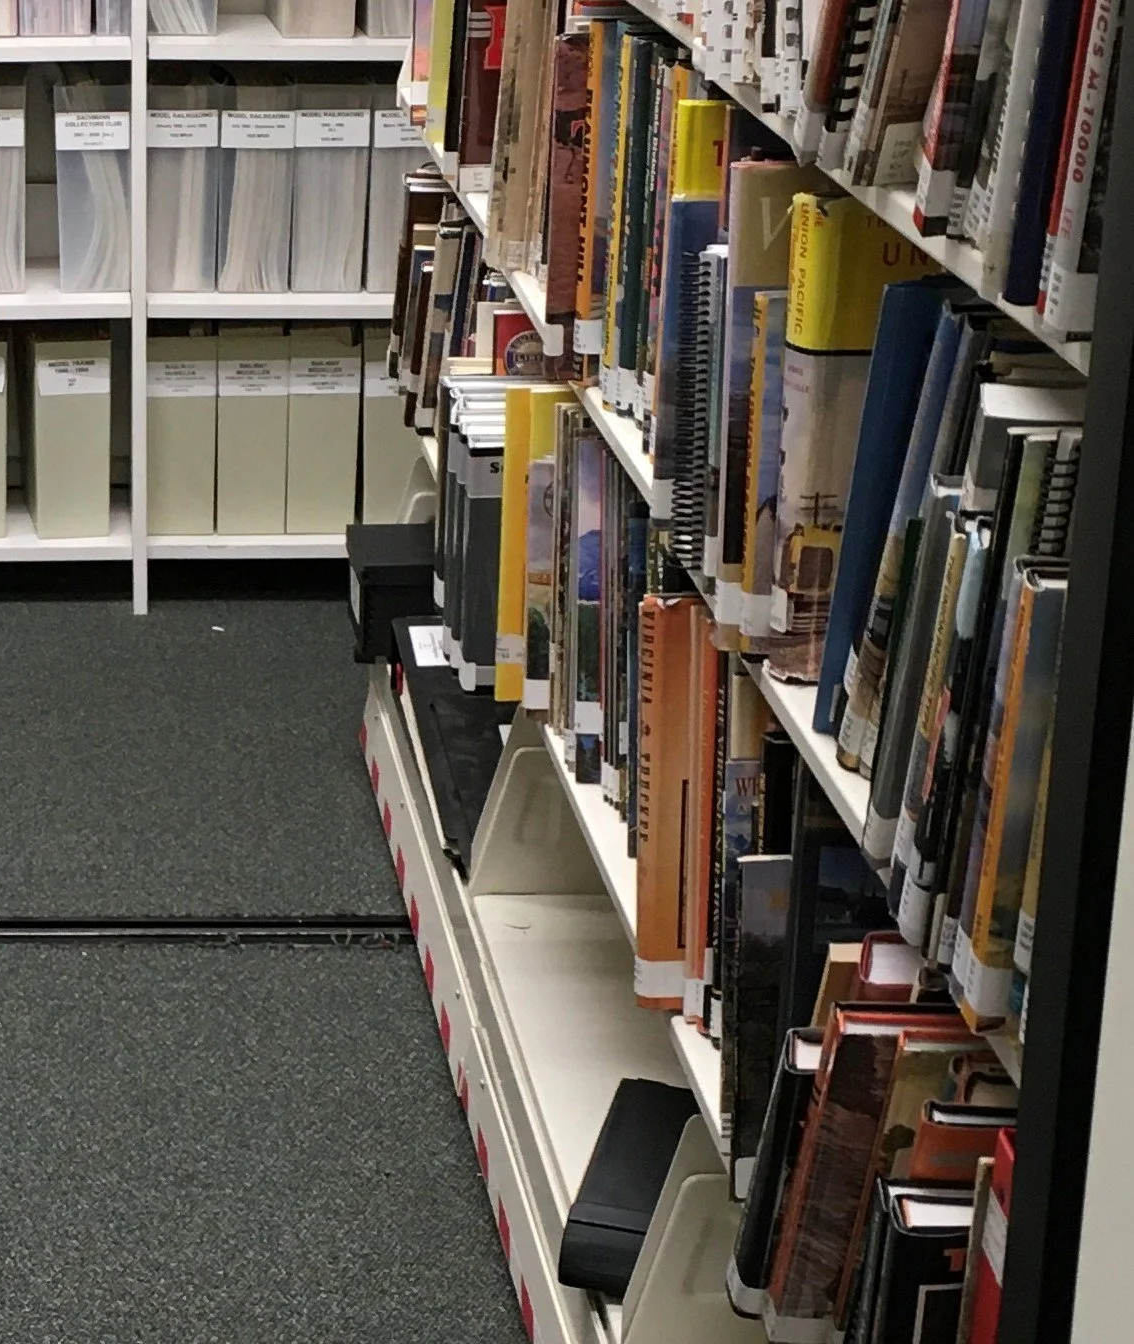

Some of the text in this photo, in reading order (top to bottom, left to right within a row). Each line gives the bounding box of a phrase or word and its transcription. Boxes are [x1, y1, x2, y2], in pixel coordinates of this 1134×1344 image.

[1072, 68, 1100, 184] M-10000
[794, 202, 809, 336] UNION PACIFIC
[641, 609, 656, 704] VIRGINIA
